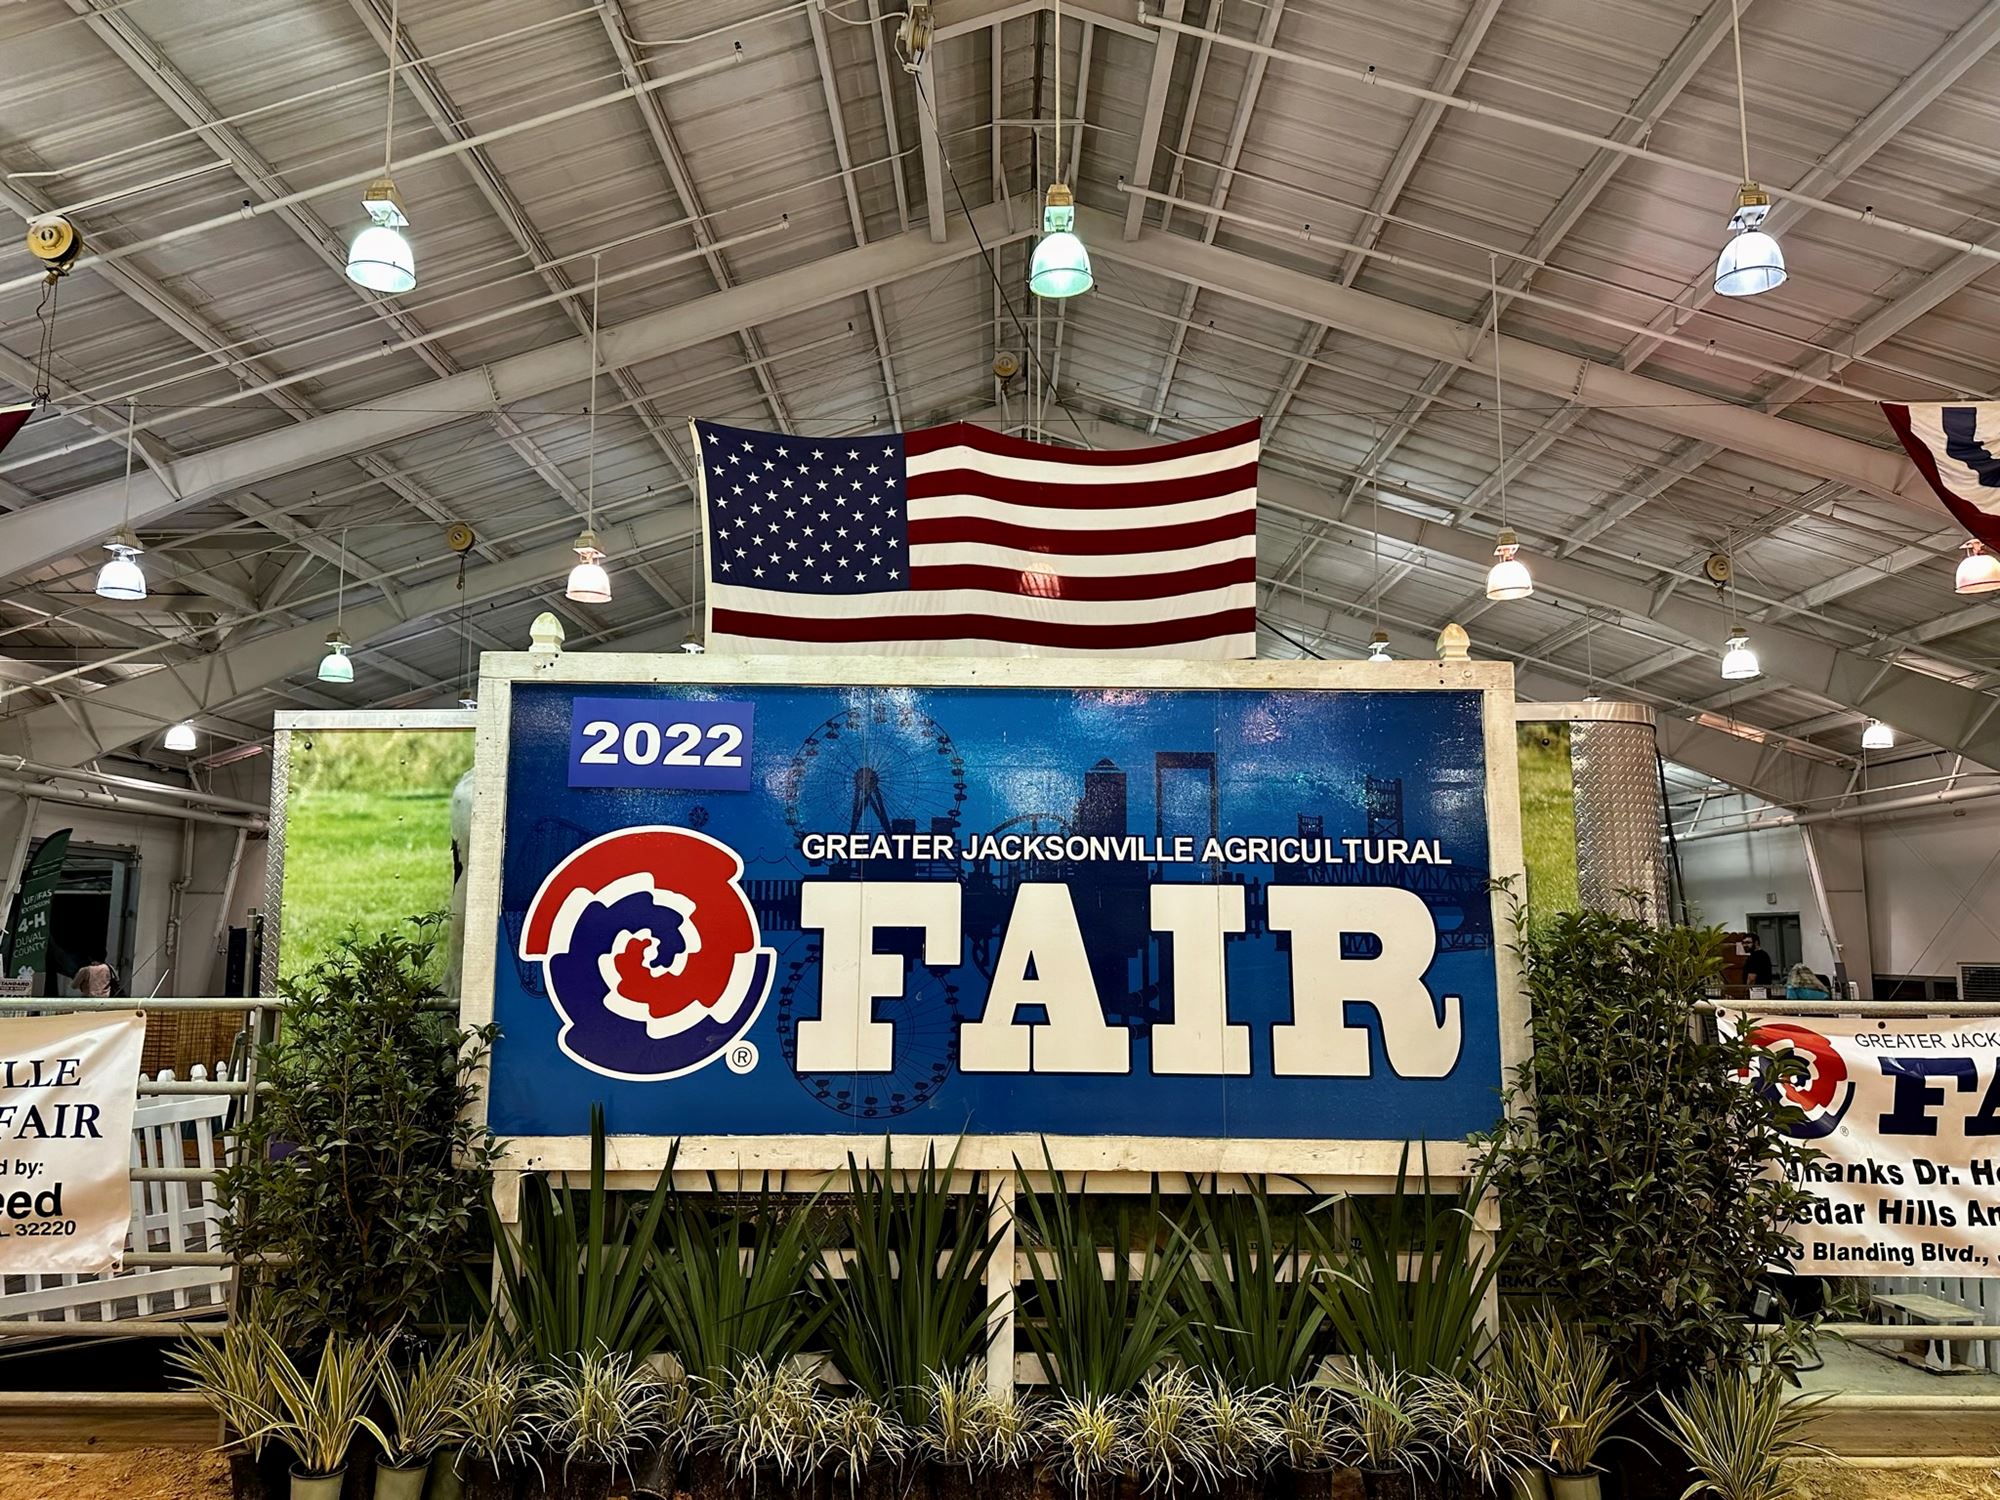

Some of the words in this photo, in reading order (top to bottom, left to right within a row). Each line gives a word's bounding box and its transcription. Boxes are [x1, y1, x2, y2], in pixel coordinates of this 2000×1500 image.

[580, 721, 743, 768] 2022
[802, 834, 954, 860] GREATER
[962, 835, 1194, 862] JACKSONVILLE
[1202, 837, 1452, 865] AGRICULTURAL
[18, 911, 46, 933] 4-H
[12, 941, 46, 958] COUNTY
[15, 931, 46, 948] DUVAL
[796, 881, 1461, 1077] FAIR
[1855, 1033, 1946, 1049] GREATER
[1951, 1032, 2000, 1048] JACK
[0, 1059, 82, 1089] LLE
[15, 1159, 43, 1179] by:
[1913, 1158, 1960, 1185] Dr.
[1971, 1159, 2000, 1185] H
[0, 1182, 63, 1219] eed
[1878, 1199, 1957, 1227] Hills
[15, 1220, 76, 1236] 32220
[1813, 1243, 1914, 1266] Blanding
[1921, 1243, 1989, 1266] Blvd.,
